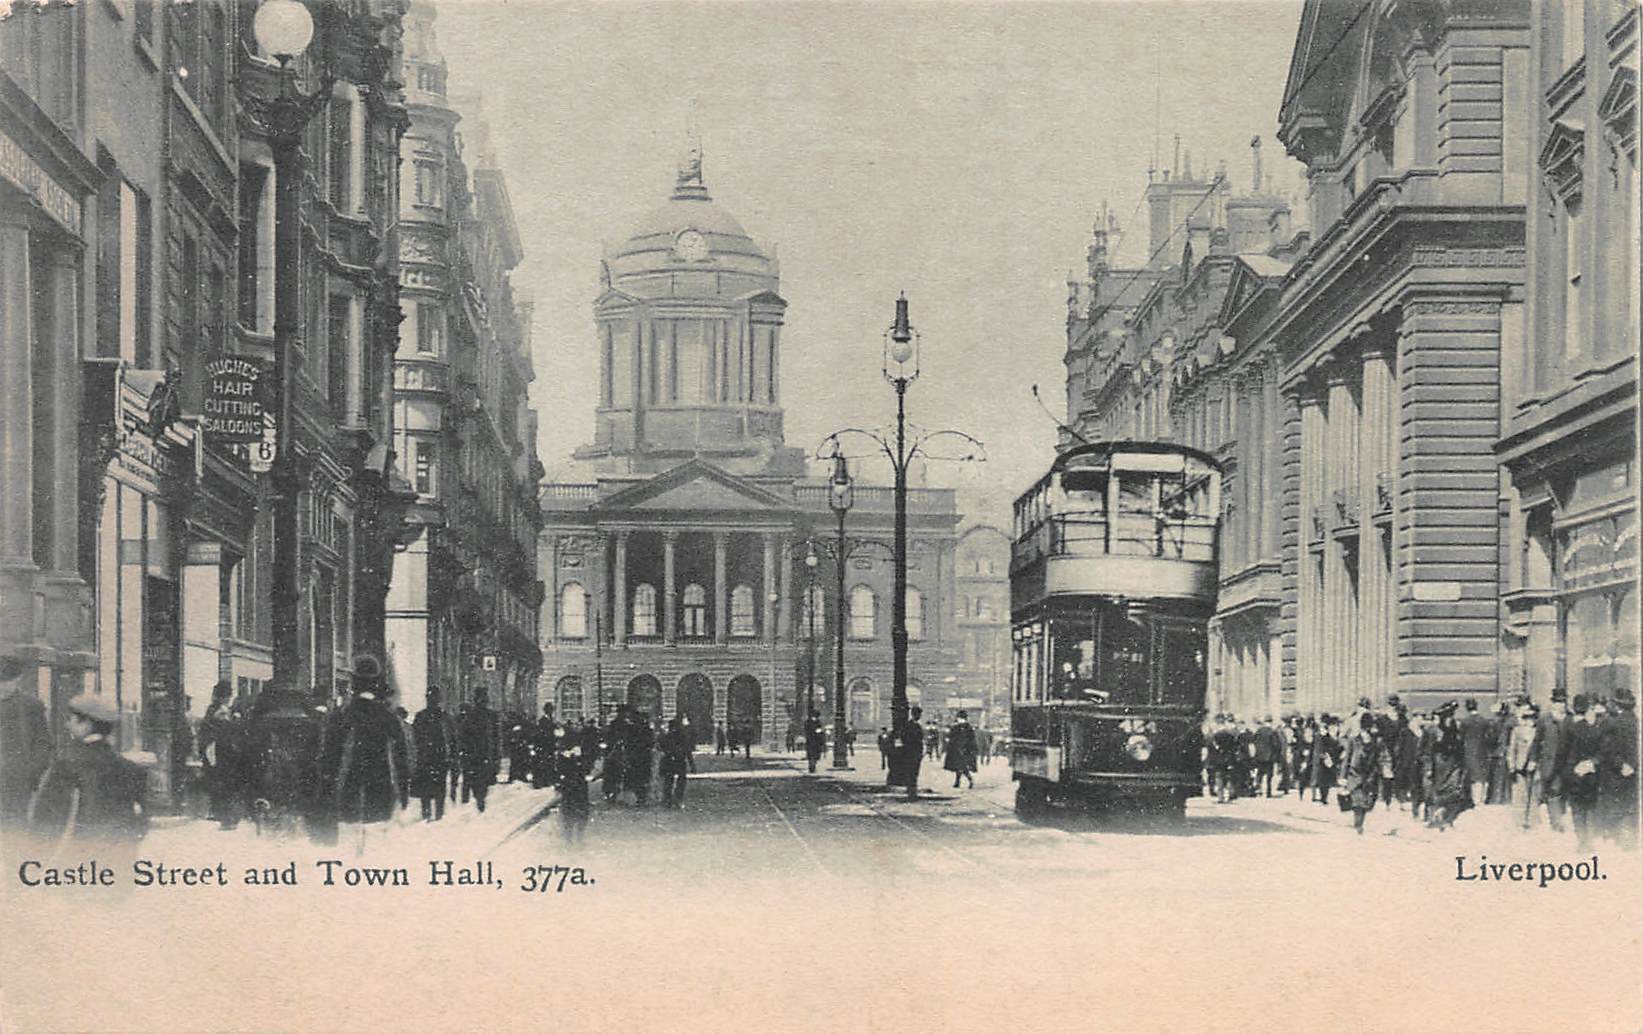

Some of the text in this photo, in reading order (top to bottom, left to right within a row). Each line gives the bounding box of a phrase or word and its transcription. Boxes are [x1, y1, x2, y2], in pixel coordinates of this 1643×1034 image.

[212, 380, 253, 396] HAIR
[204, 398, 261, 416] CUTTING
[204, 418, 262, 434] SALOONS
[259, 441, 272, 461] 6
